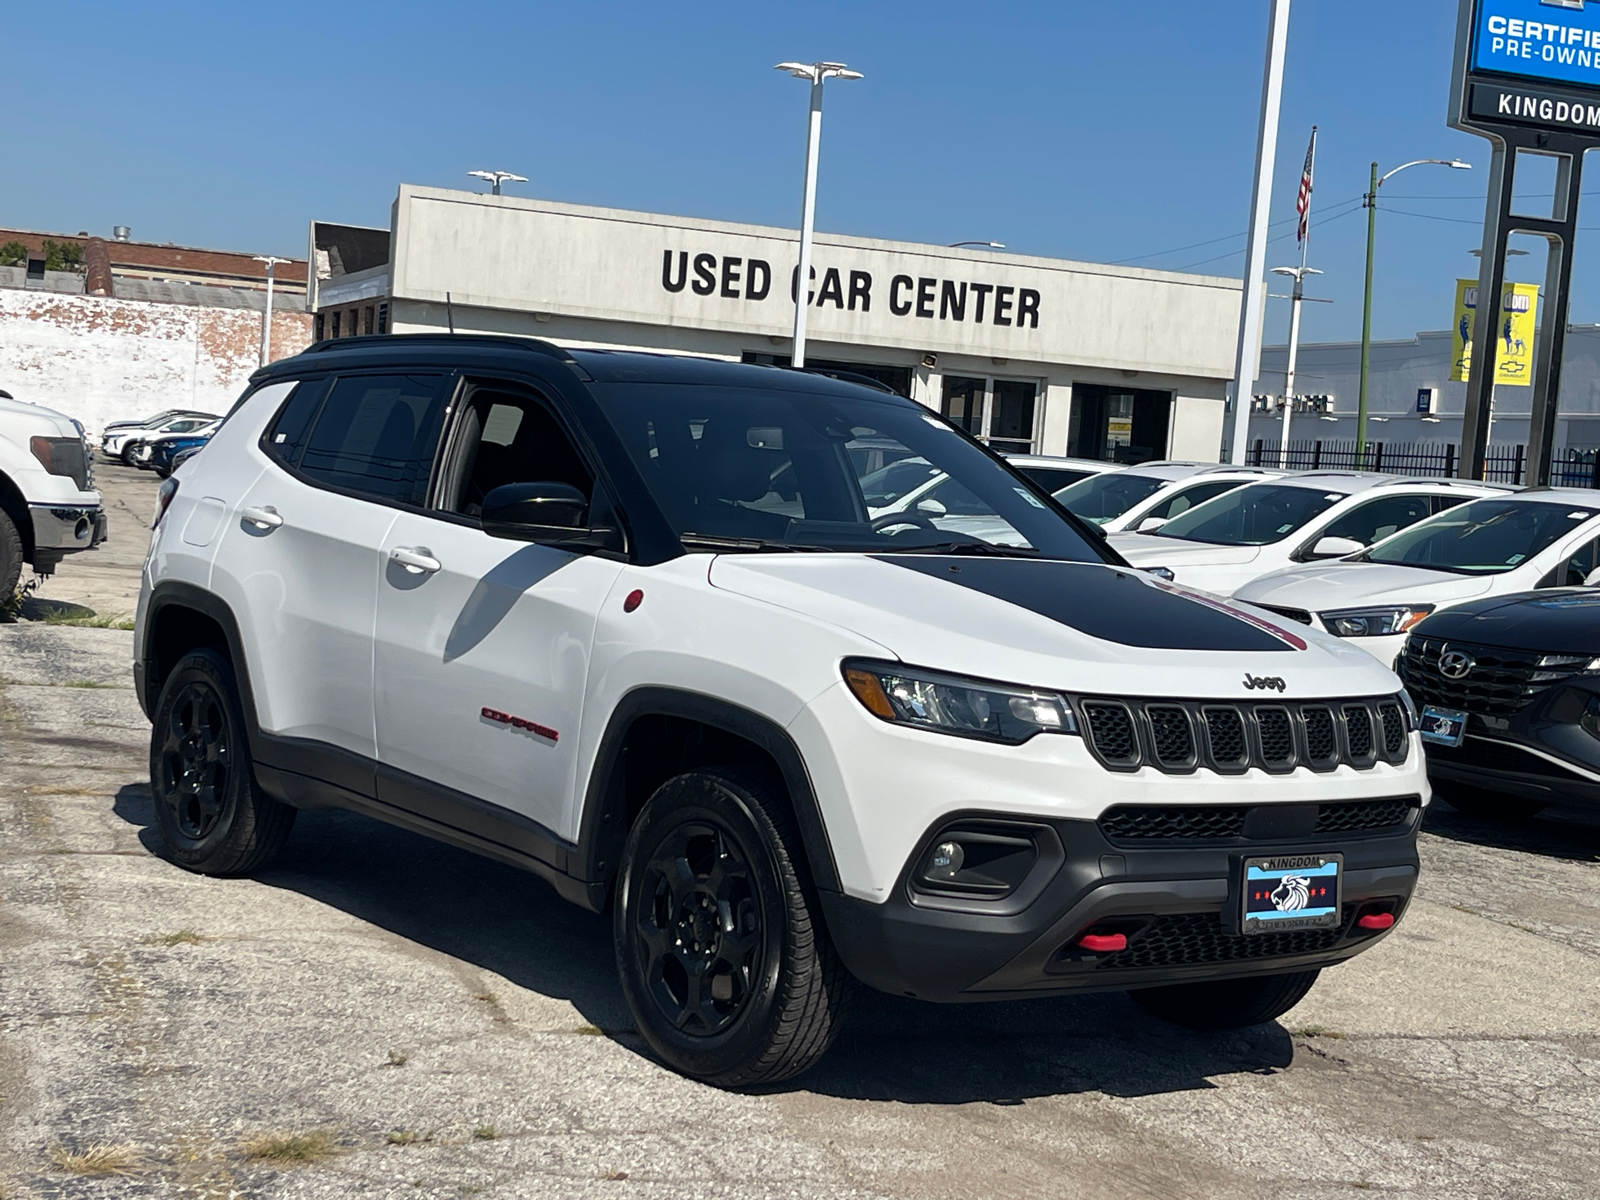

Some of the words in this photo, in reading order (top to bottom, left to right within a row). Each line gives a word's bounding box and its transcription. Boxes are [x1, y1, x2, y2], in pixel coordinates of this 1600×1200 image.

[1498, 93, 1600, 127] KINGDOM
[662, 249, 771, 301] USED
[791, 263, 873, 312] CAR
[889, 274, 1041, 329] CENTER
[1242, 672, 1287, 693] Jeep
[1269, 856, 1321, 869] KINGDOM
